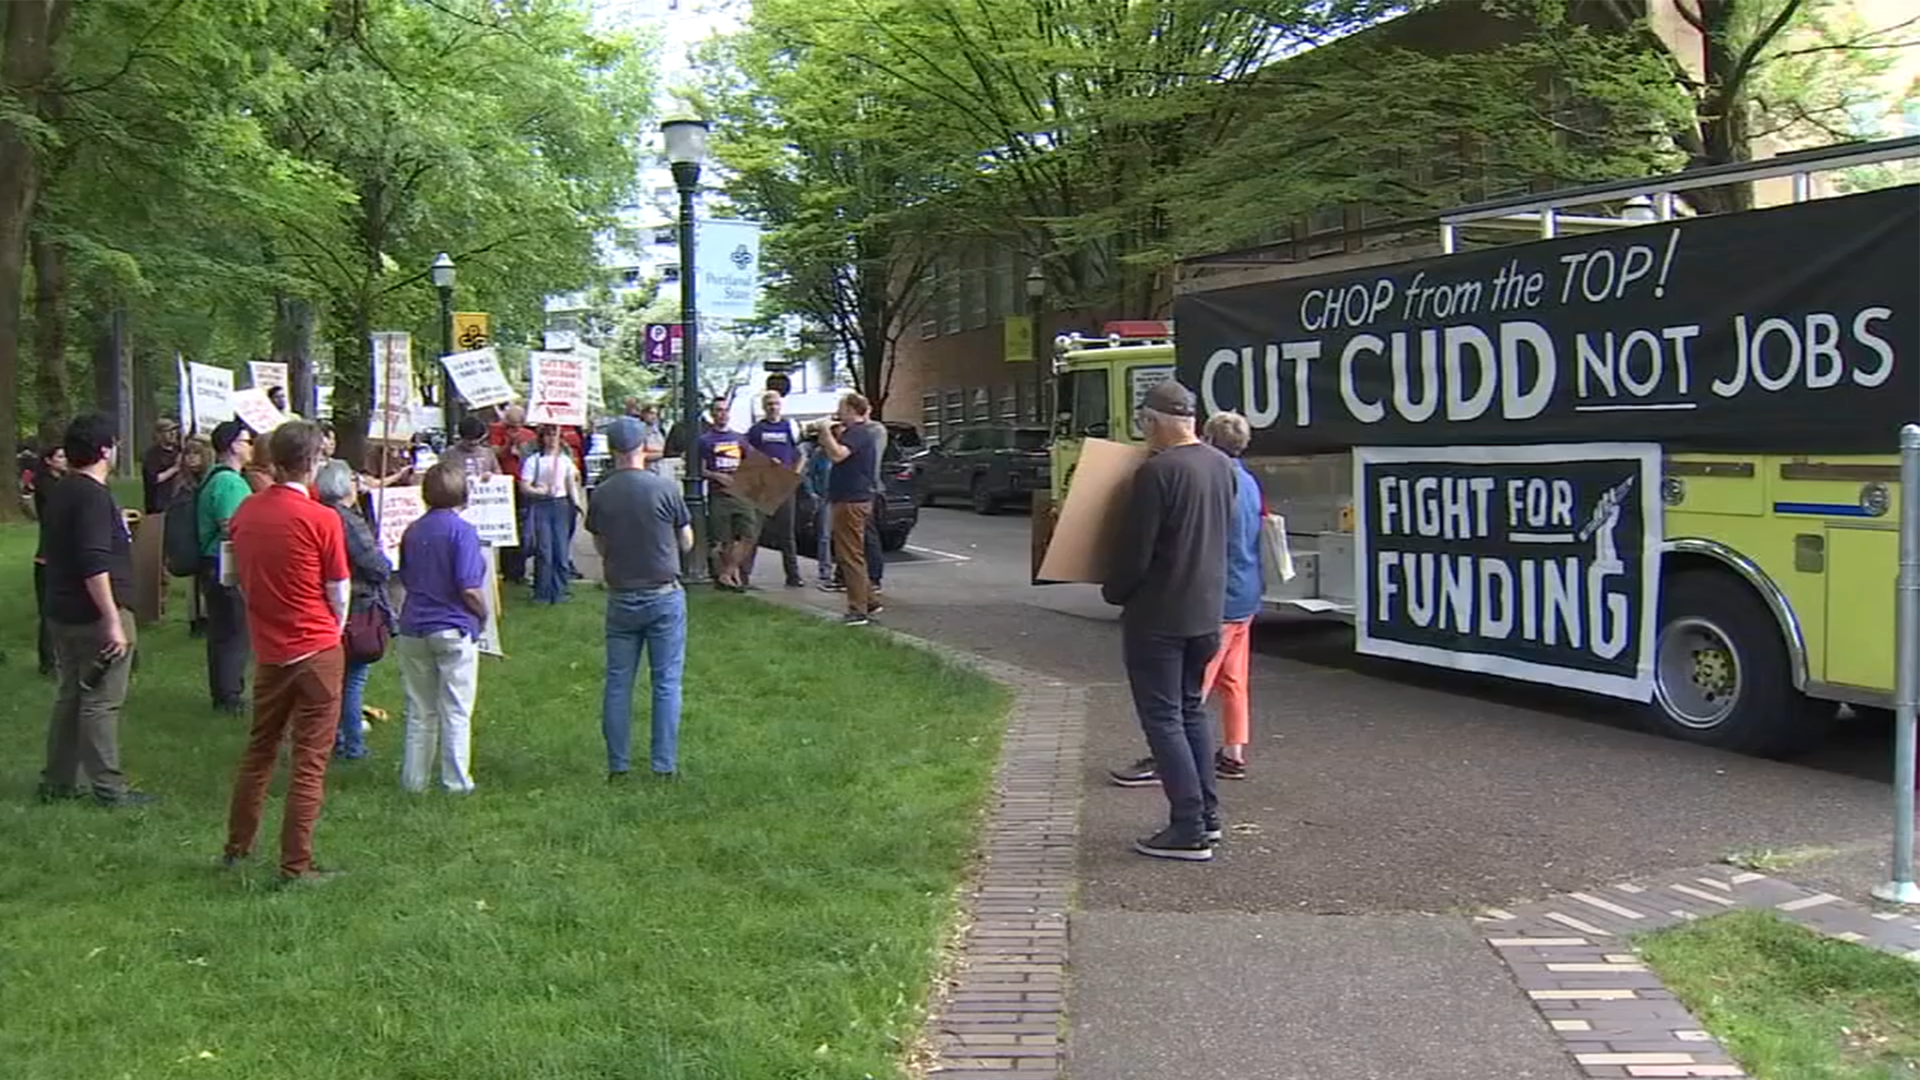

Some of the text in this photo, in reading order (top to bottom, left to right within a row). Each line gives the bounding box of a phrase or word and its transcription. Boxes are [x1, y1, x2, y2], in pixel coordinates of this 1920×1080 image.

[1300, 228, 1681, 331] CHOP from the TOP!
[652, 342, 664, 357] 4
[1201, 306, 1894, 429] CUT CUDD NOT JOBS
[1378, 476, 1573, 540] FIGHT FOR
[1377, 550, 1628, 660] FUNDING
